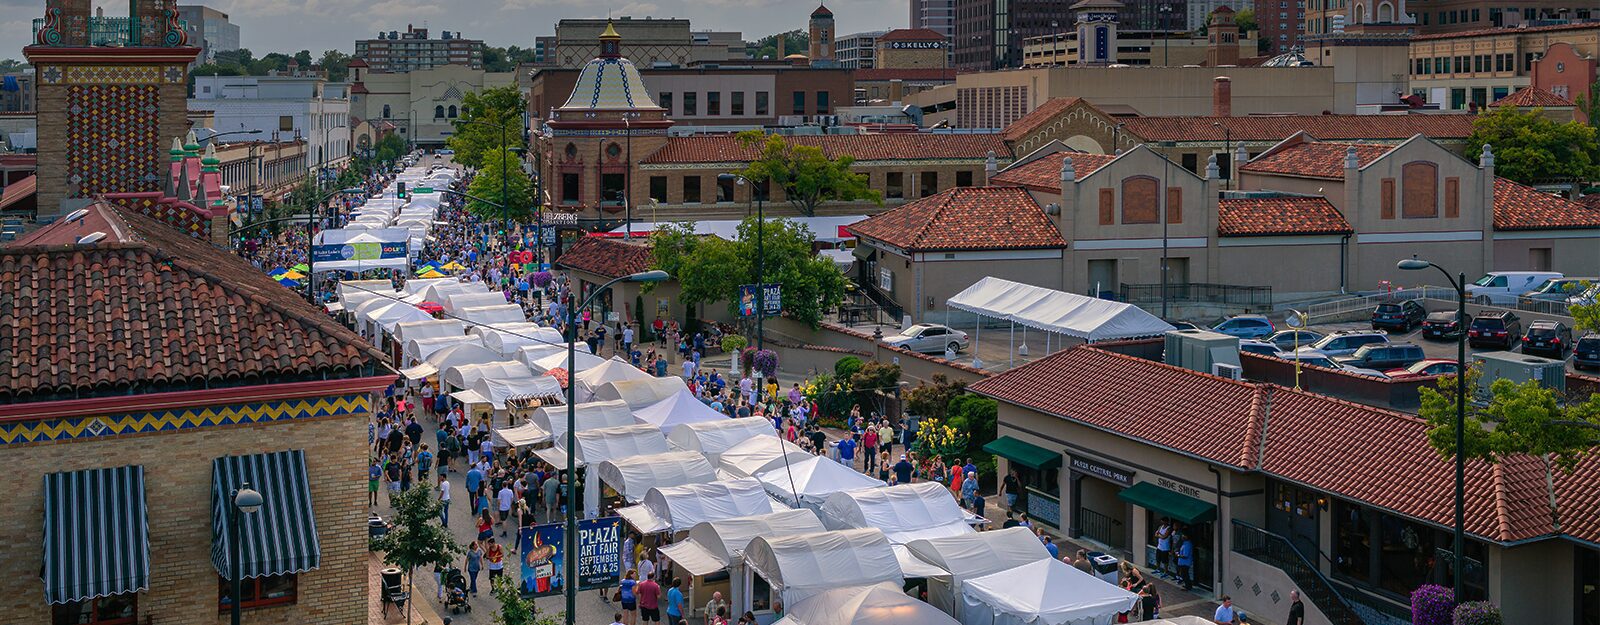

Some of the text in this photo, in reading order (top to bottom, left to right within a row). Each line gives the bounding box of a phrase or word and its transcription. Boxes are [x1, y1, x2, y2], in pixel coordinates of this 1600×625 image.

[543, 212, 578, 220] HELZBERG
[509, 250, 533, 265] GO
[1073, 459, 1128, 482] PLAZA CENTRAL PARK
[1157, 477, 1201, 498] SHOE SHINE
[580, 527, 618, 545] PLAZA
[580, 542, 618, 557] ART FAIR
[580, 553, 618, 566] SEPTEMBER
[580, 562, 618, 576] 23, 24 & 25
